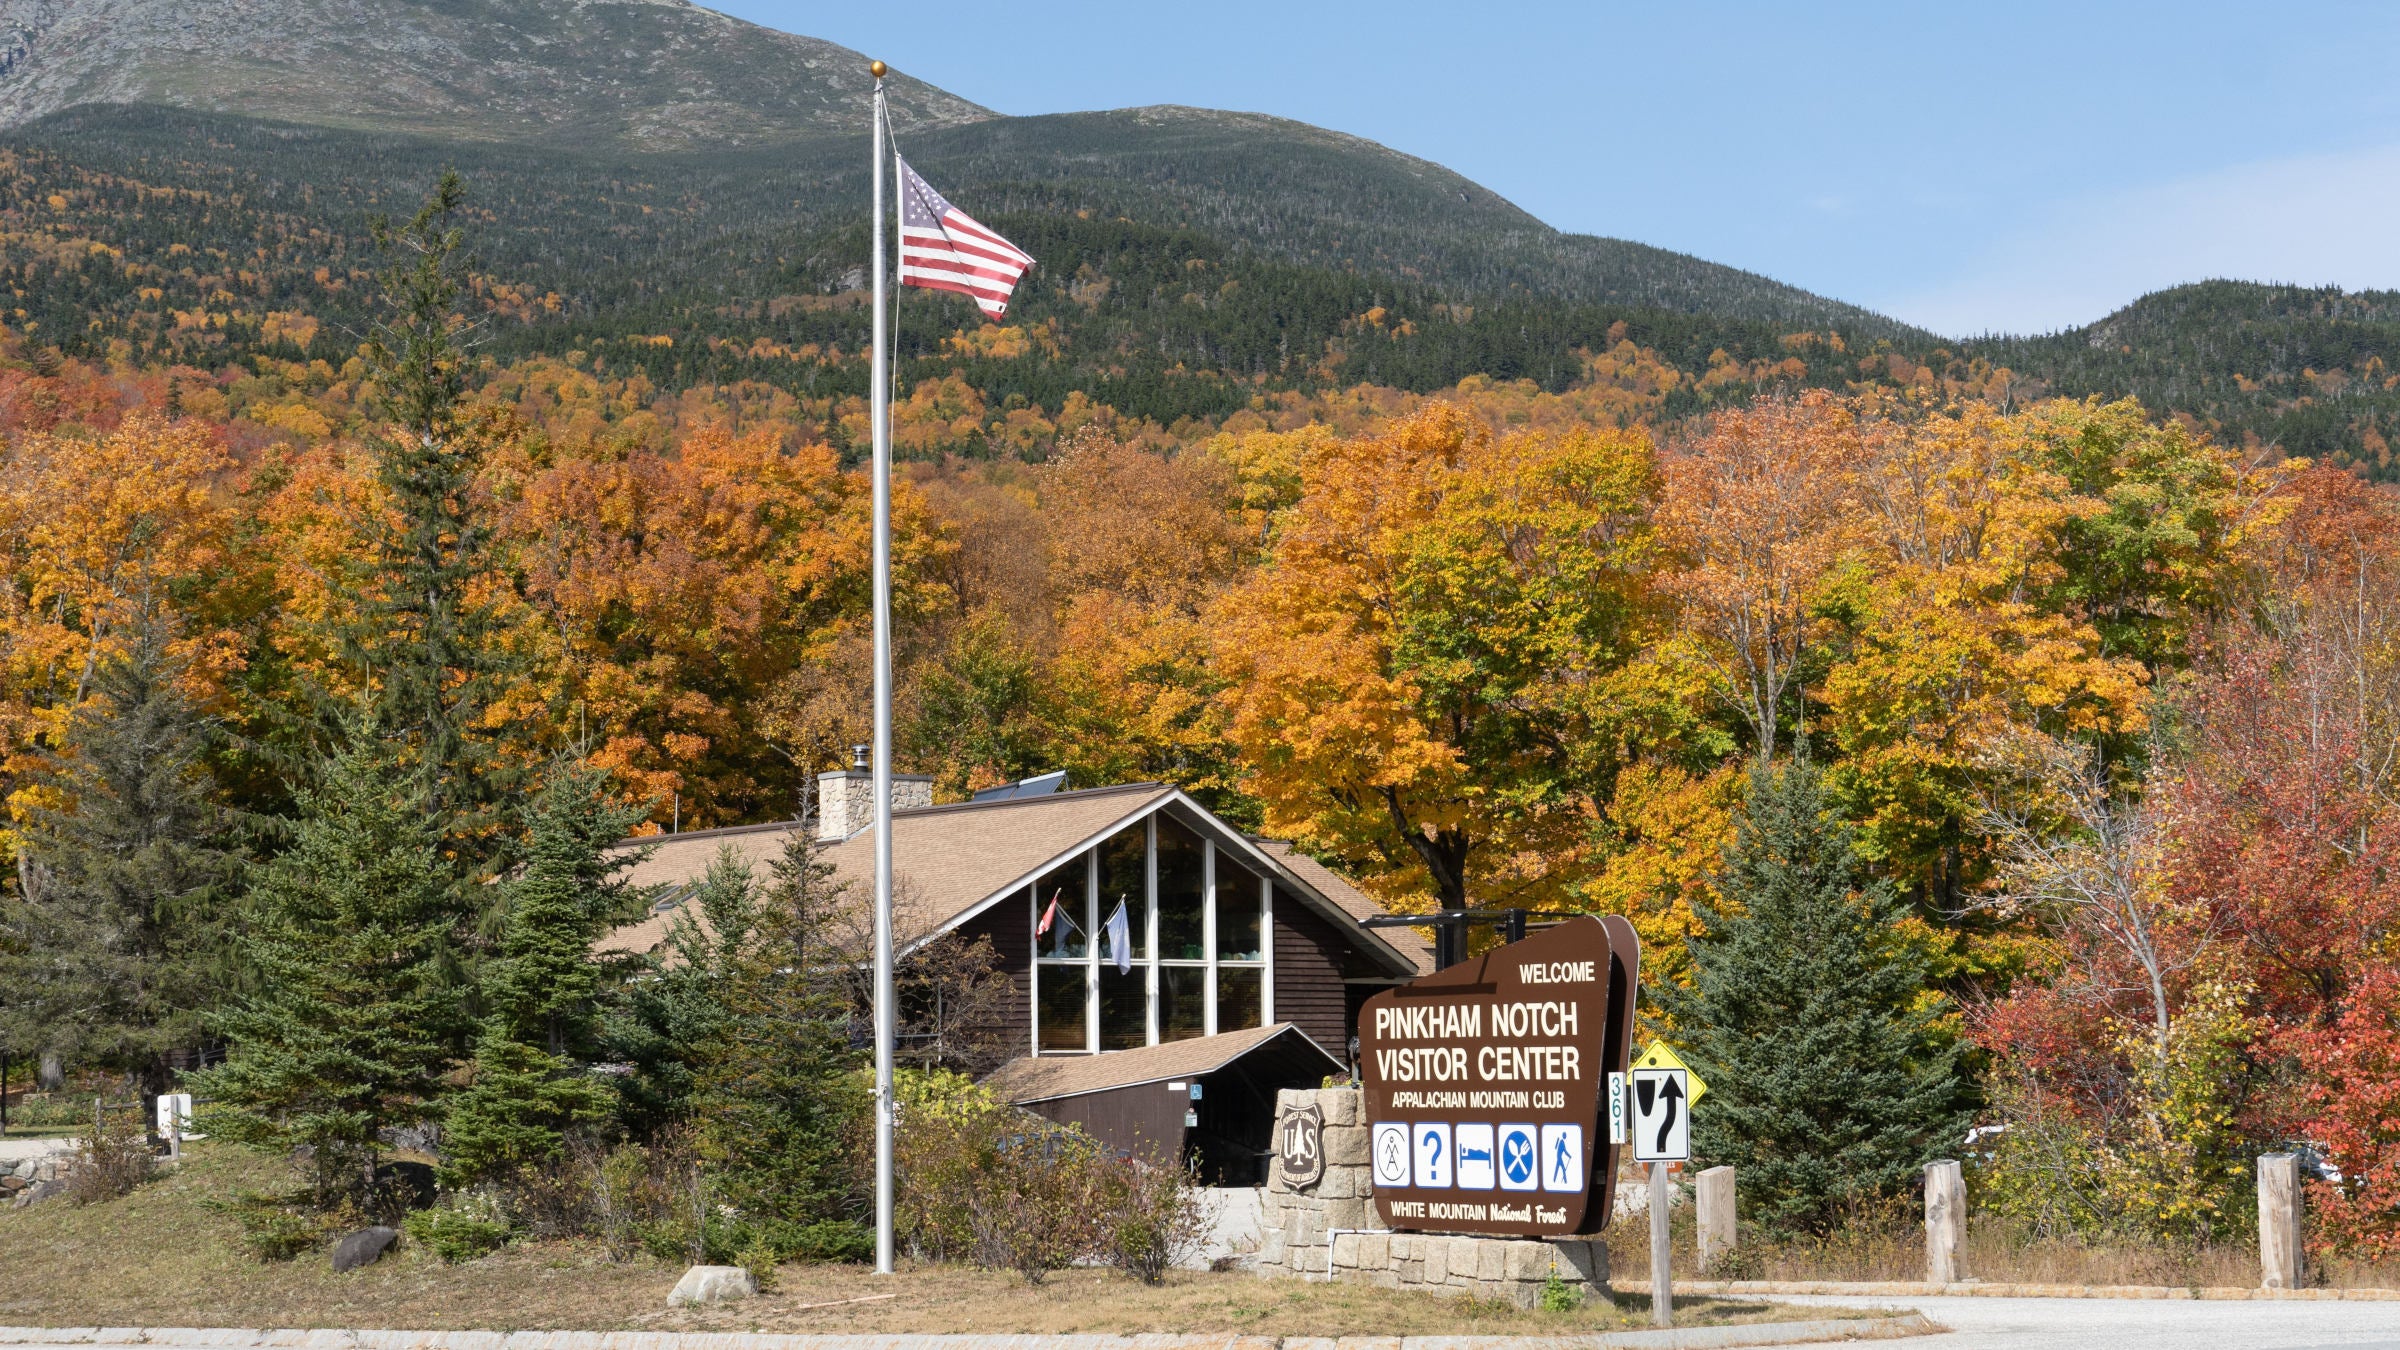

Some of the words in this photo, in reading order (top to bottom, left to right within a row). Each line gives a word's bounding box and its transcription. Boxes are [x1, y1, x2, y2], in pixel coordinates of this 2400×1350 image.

[1519, 962, 1595, 984] WELCOME
[1376, 1005, 1481, 1039] PINKHAM
[1492, 1002, 1577, 1037] NOTCH
[1376, 1047, 1468, 1081] VISITOR
[1478, 1046, 1580, 1081] CENTER
[1392, 1091, 1466, 1108] APPALACHIAN
[1470, 1091, 1528, 1108] MOUNTAIN
[1533, 1091, 1565, 1108] CLUB
[1611, 1076, 1622, 1139] 361
[1391, 1201, 1425, 1217] WHITE
[1429, 1203, 1486, 1220] MOUNTAIN
[1490, 1203, 1531, 1222] National
[1535, 1205, 1566, 1224] Forest
